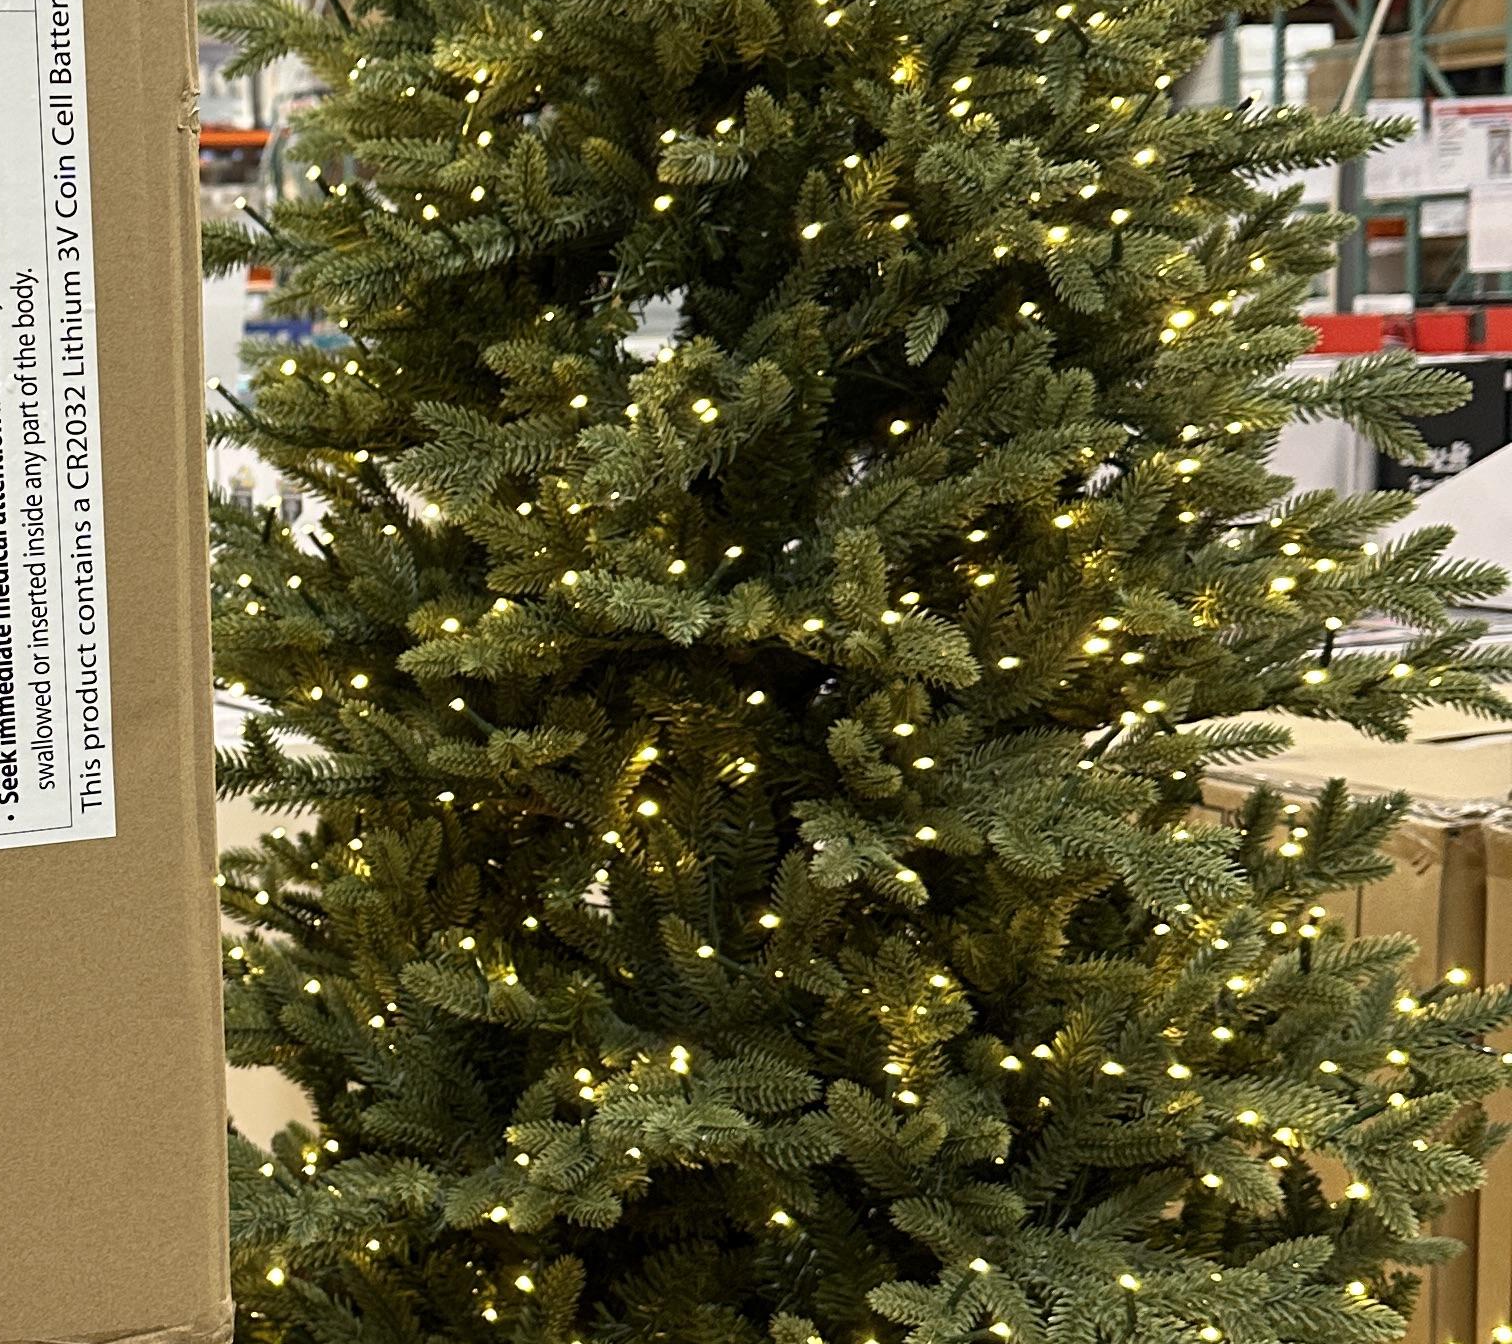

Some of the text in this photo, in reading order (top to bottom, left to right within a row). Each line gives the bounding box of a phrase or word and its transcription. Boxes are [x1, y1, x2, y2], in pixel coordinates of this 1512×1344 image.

[50, 96, 74, 145] Cell
[54, 156, 77, 218] Coin
[57, 226, 79, 261] 3V
[60, 272, 84, 376] Lithium
[65, 386, 89, 489] CR2032
[74, 499, 90, 512] a
[71, 521, 95, 635] contains
[76, 643, 105, 750] product
[80, 759, 102, 814] This
